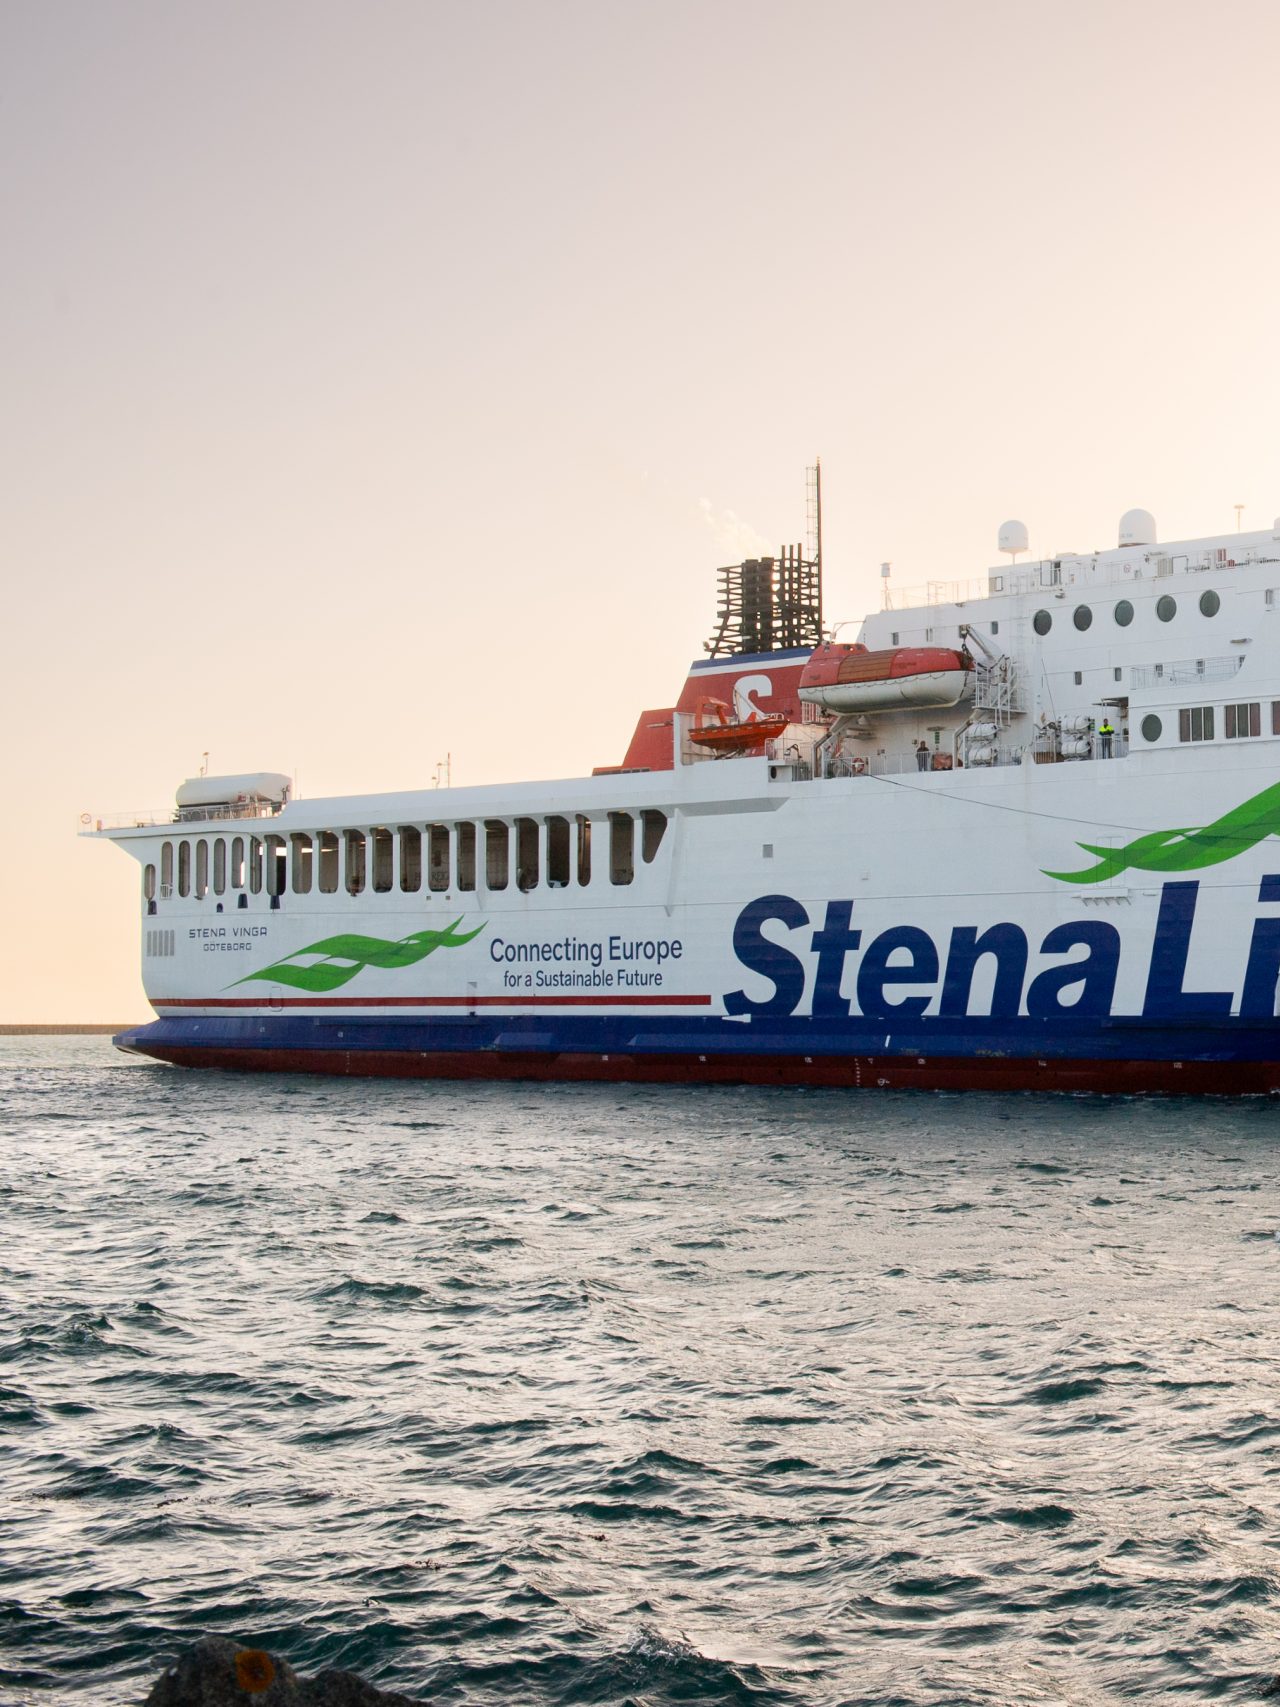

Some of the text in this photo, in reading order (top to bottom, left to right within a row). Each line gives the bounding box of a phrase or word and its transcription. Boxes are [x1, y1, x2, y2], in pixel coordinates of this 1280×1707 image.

[189, 926, 267, 938] STENA VINGA
[490, 936, 683, 967] Connecting Europe
[722, 894, 1121, 1017] Stena
[504, 969, 663, 987] for a Sustainable Future
